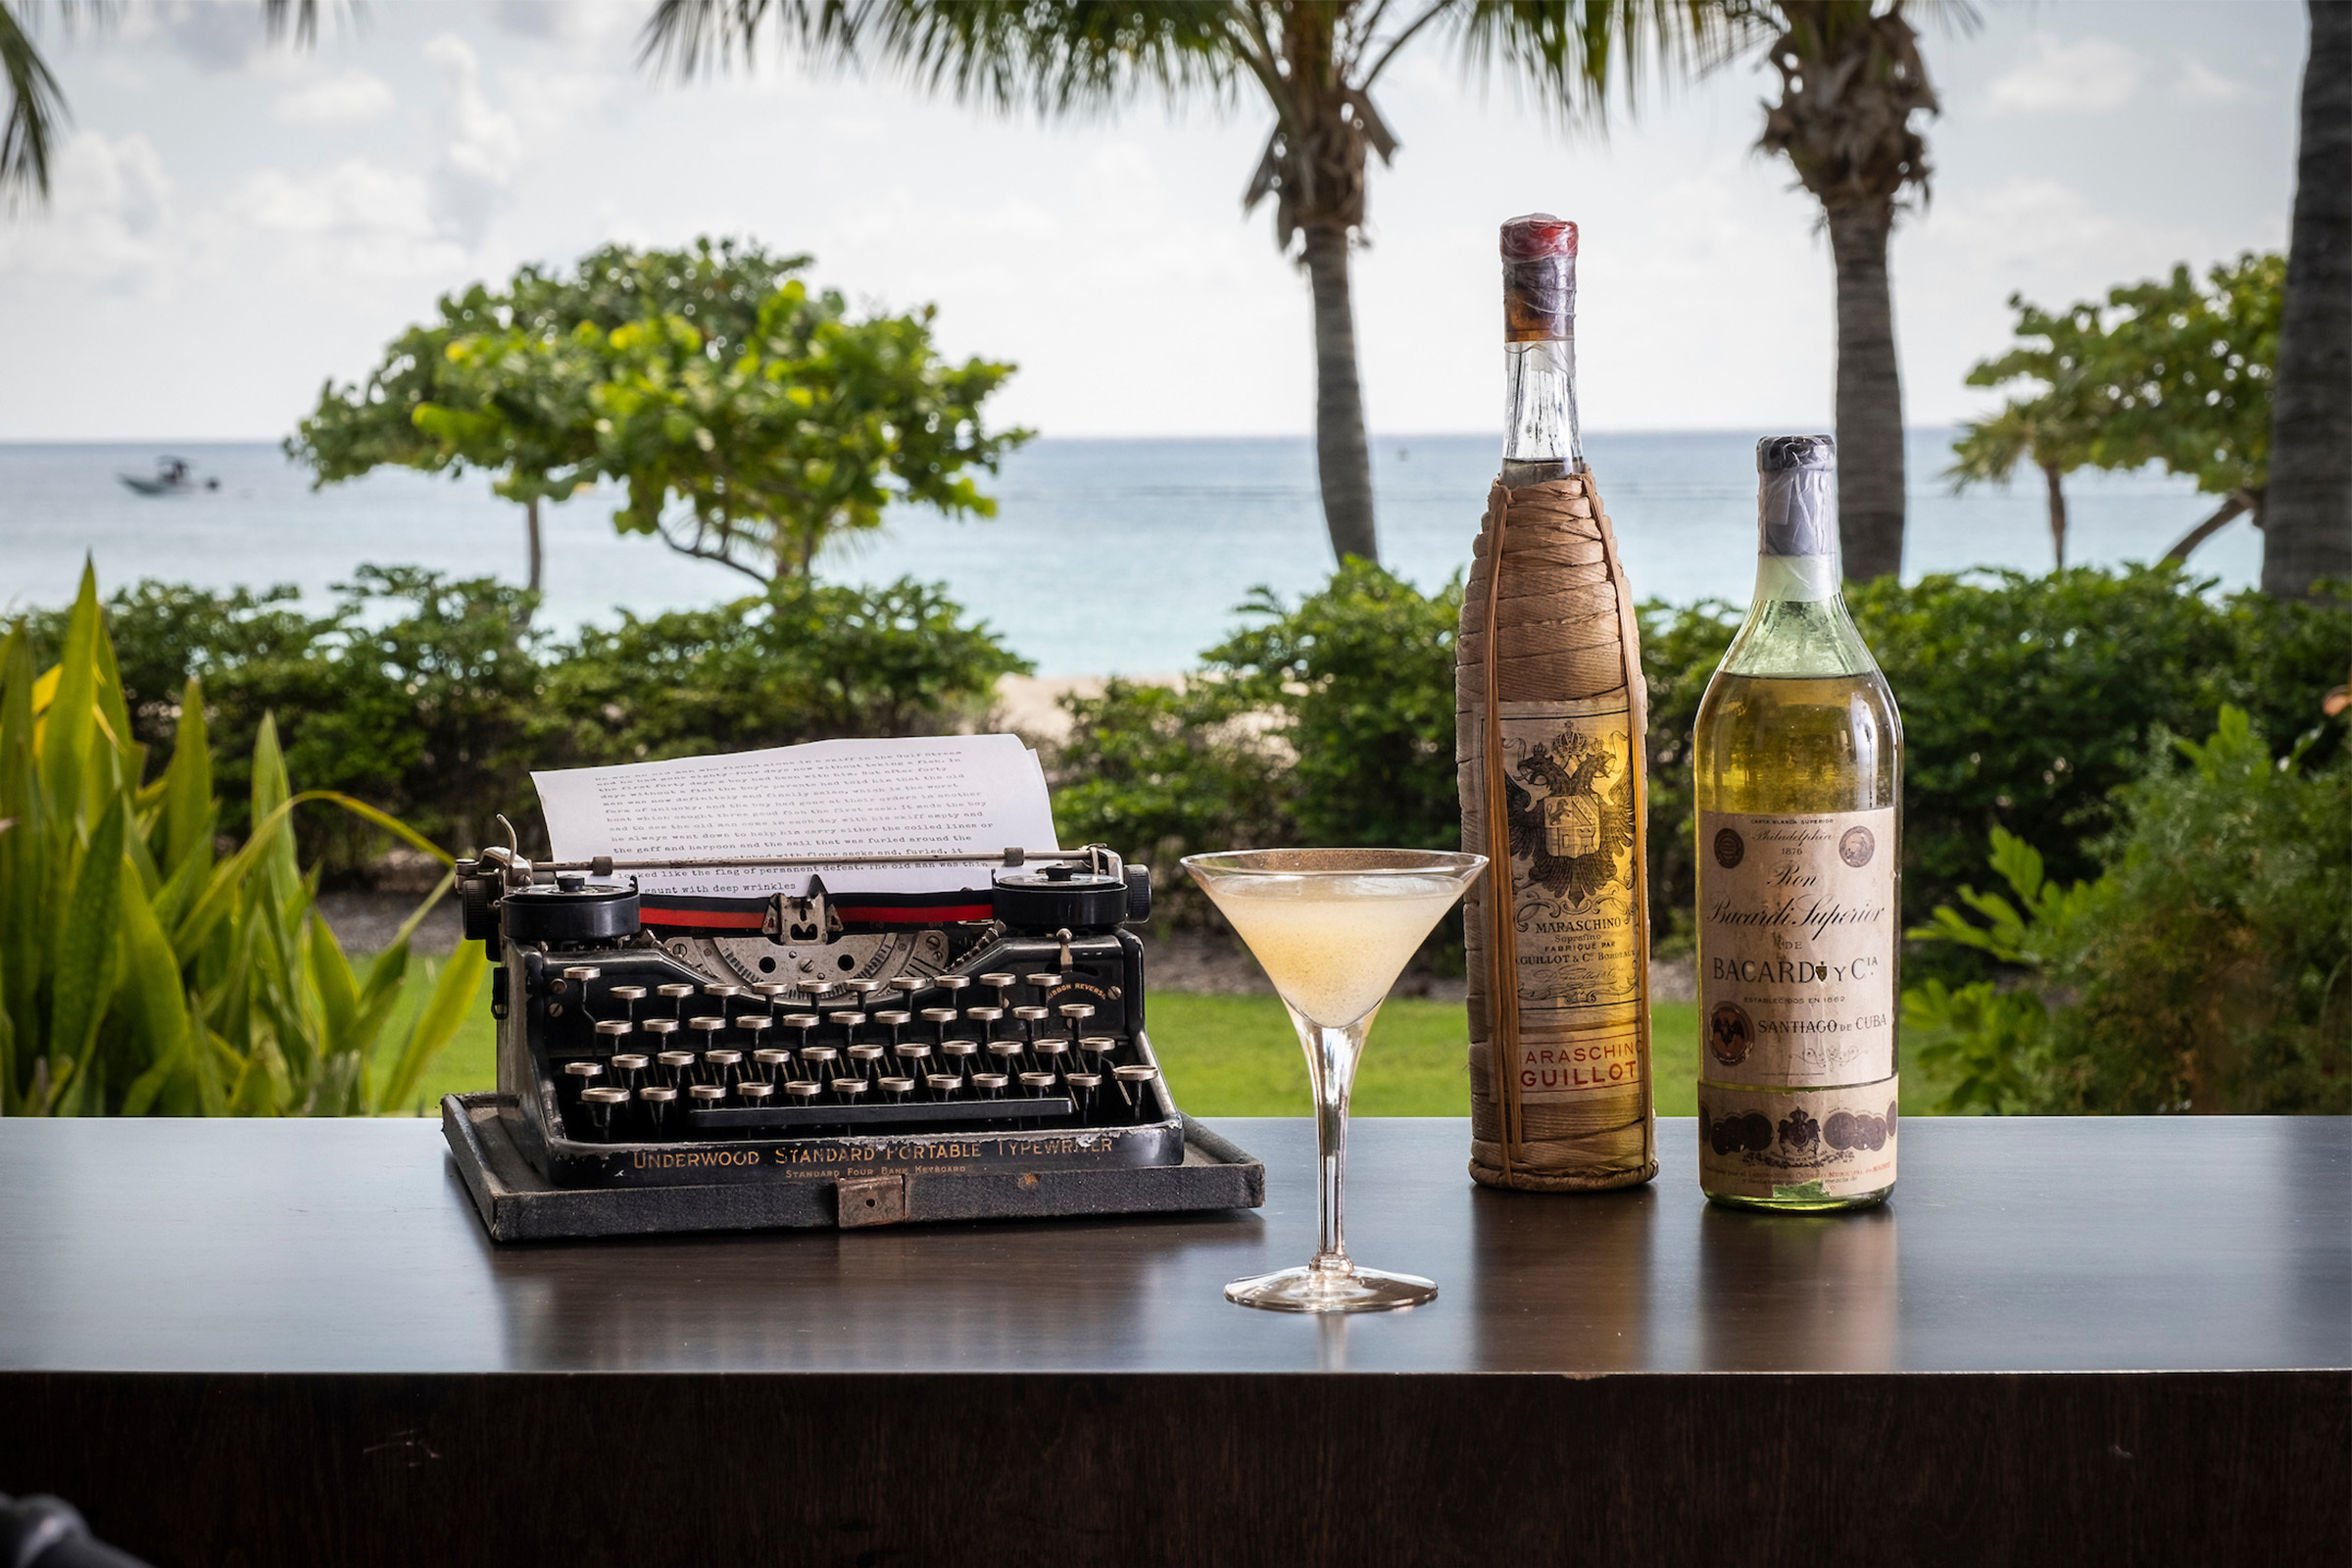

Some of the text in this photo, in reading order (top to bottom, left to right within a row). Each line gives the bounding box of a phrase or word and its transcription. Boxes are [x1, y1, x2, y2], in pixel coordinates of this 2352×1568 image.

[1751, 828, 1833, 847] Philadelphia
[619, 869, 656, 878] loked
[662, 868, 687, 877] like
[715, 867, 739, 876] flag
[743, 866, 756, 874] of
[760, 864, 819, 875] permanent
[823, 862, 863, 871] defeat.
[891, 861, 910, 869] old
[962, 859, 988, 867] thin
[1767, 859, 1819, 887] Ron
[682, 885, 708, 893] with
[713, 884, 738, 893] deep
[743, 882, 795, 891] wrinkles
[1535, 917, 1621, 933] MARASCHINO
[1792, 894, 1885, 941] Superior
[1555, 933, 1602, 943] Soprafino
[1785, 941, 1803, 950] DE
[1598, 950, 1635, 960] BORDEAUX
[1714, 957, 1828, 983] BACARD
[1834, 966, 1846, 981] Y
[1758, 1019, 1838, 1034] SANTIAGO
[1856, 1014, 1887, 1030] CUBA
[1525, 1040, 1643, 1064] ARASCHINO
[1520, 1060, 1636, 1087] GUILLOT
[634, 1151, 760, 1169] UNDERWOOD
[775, 1147, 875, 1164] STANDARD
[786, 1170, 840, 1178] STANDARD
[847, 1168, 873, 1176] FOUR
[915, 1165, 966, 1174] KEYBOARD
